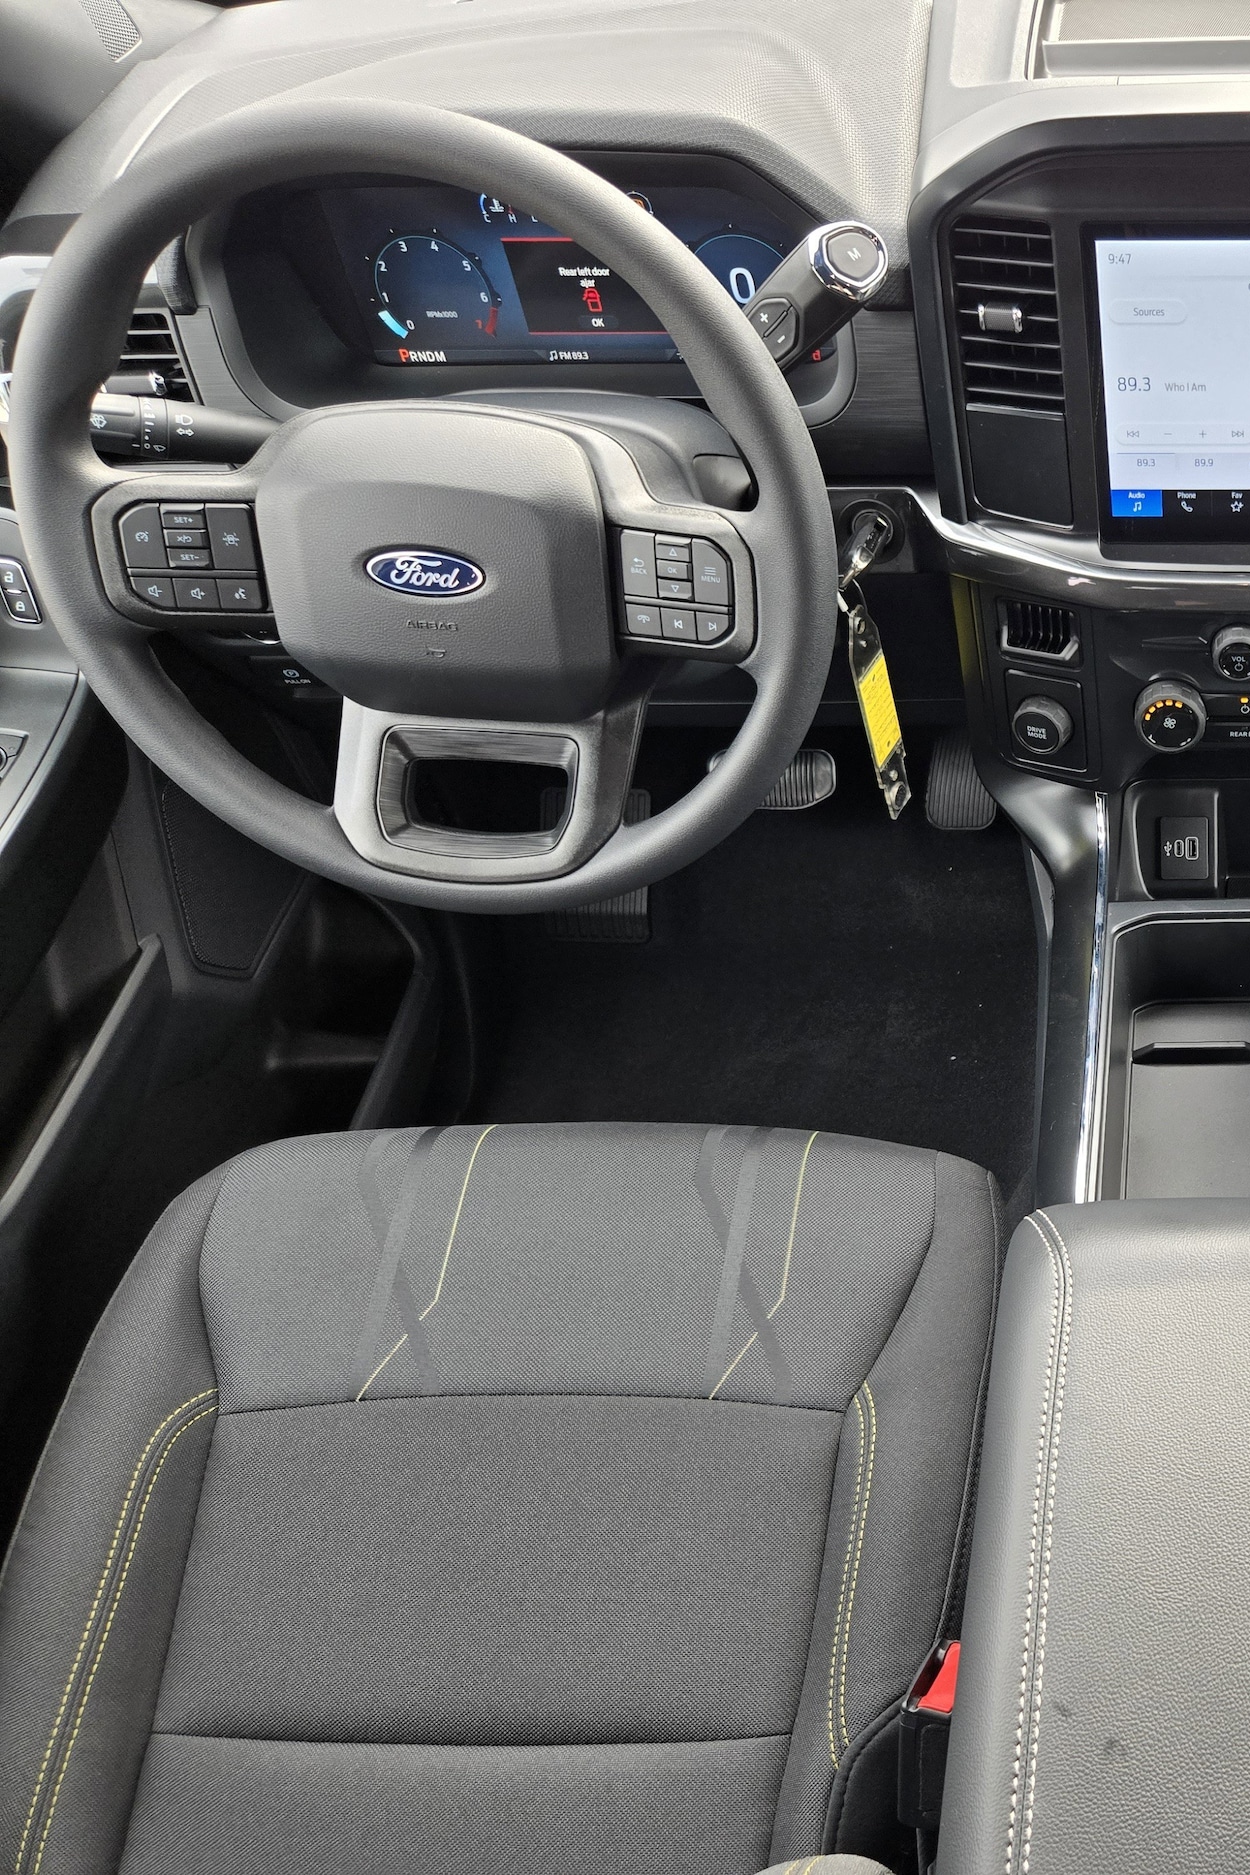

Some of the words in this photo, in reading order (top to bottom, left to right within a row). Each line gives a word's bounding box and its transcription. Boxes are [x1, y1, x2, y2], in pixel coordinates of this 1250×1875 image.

[508, 213, 517, 223] H
[398, 241, 408, 253] 3
[430, 241, 439, 252] 4
[847, 248, 861, 261] M
[1107, 253, 1132, 265] 9:47
[378, 261, 388, 272] 2
[462, 261, 472, 271] 5
[558, 267, 577, 276] Rear
[577, 267, 592, 276] left
[592, 267, 610, 276] door
[580, 278, 595, 288] ajar
[382, 292, 390, 302] 1
[480, 292, 488, 302] 6
[1133, 307, 1165, 317] Sources
[406, 319, 415, 330] 0
[591, 318, 605, 327] OK
[559, 351, 571, 360] FM
[1117, 376, 1151, 392] 89.3
[1164, 382, 1185, 392] Who
[1191, 382, 1207, 392] Am
[1136, 458, 1156, 467] 89.3
[1194, 458, 1214, 467] 89.9
[1128, 490, 1146, 500] Audio
[1177, 490, 1197, 500] Phone
[1231, 490, 1243, 500] Fav
[390, 556, 460, 588] Ford
[630, 565, 647, 576] BACK
[667, 565, 677, 575] OK
[701, 574, 721, 584] MENU
[407, 619, 458, 632] AIRBAG
[1026, 724, 1047, 735] DRIVE
[1230, 730, 1248, 738] REAR
[1027, 730, 1047, 740] MODE
